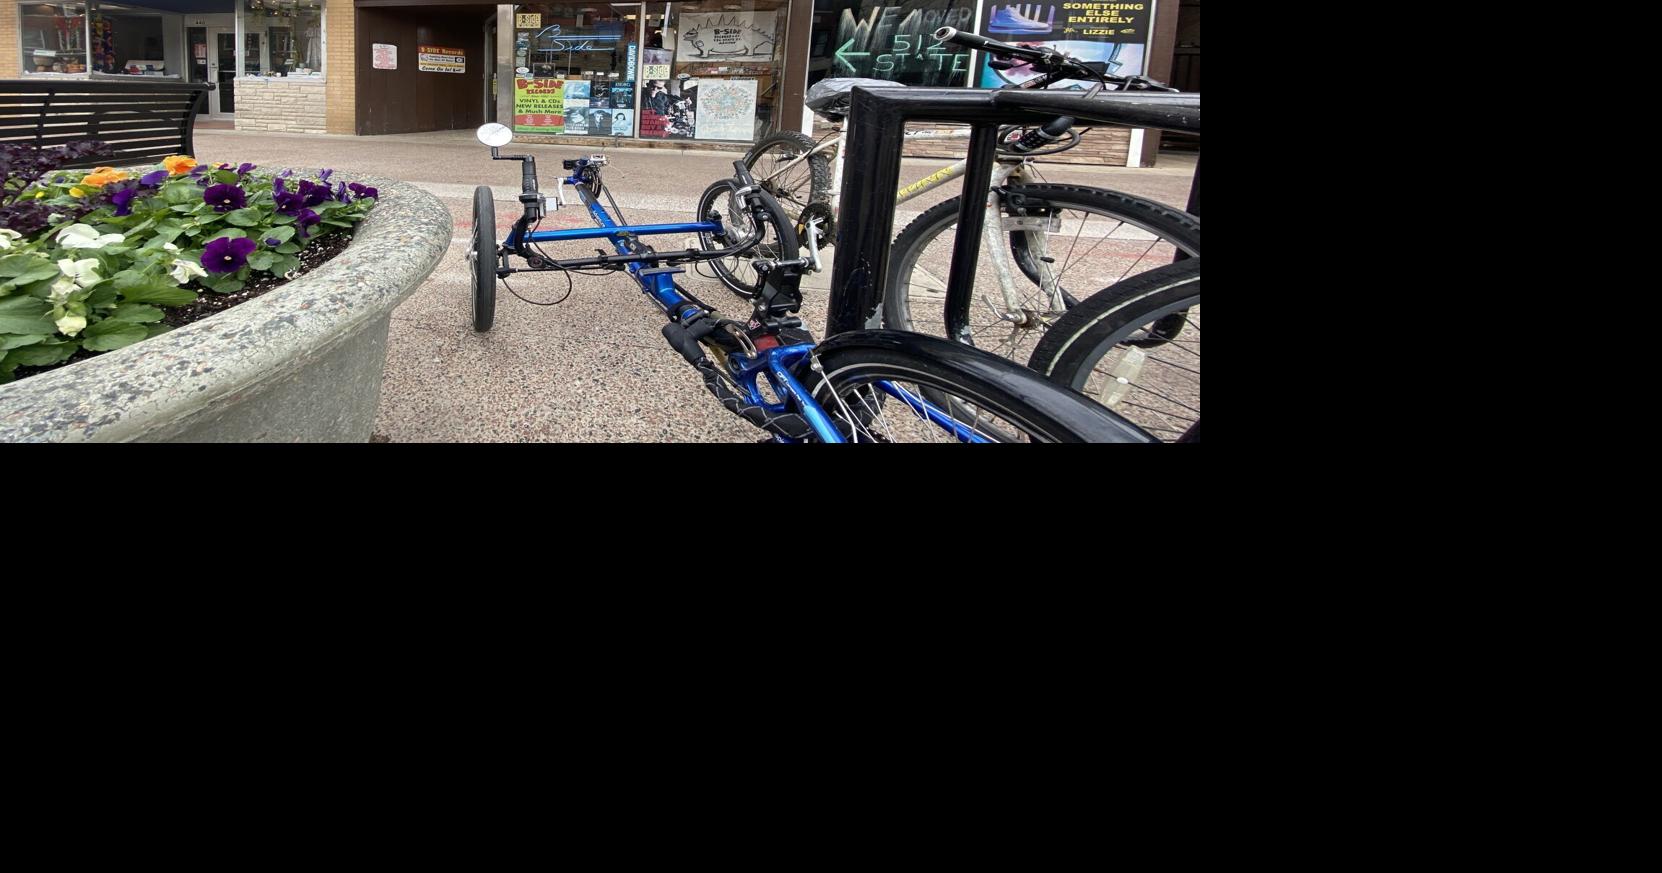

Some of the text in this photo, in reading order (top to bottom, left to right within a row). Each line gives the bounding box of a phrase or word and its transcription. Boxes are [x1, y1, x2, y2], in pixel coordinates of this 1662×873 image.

[840, 6, 973, 32] WE MOVED
[893, 34, 956, 51] 512
[873, 53, 970, 72] STATE
[517, 79, 564, 89] B-SIDE
